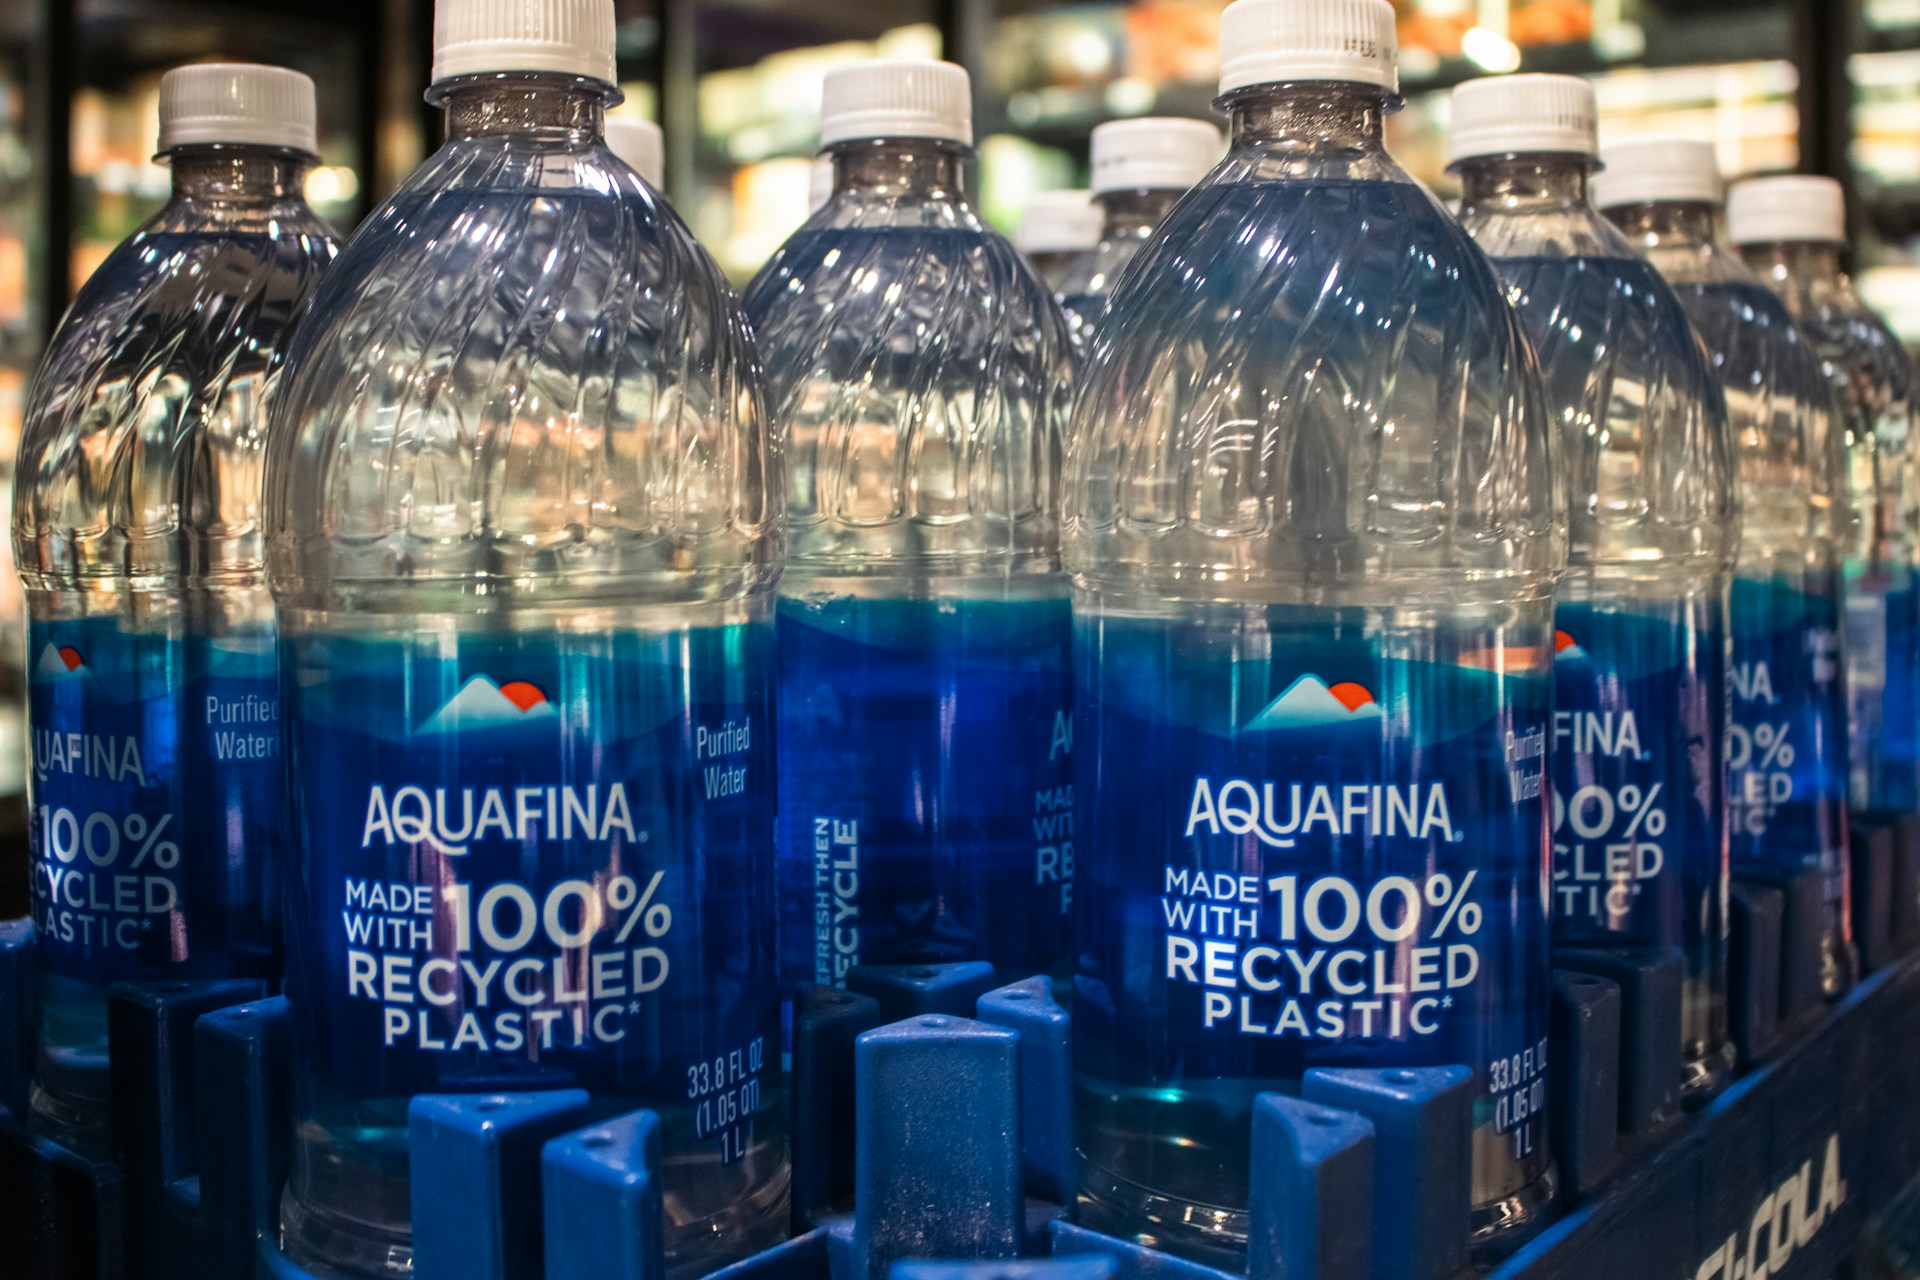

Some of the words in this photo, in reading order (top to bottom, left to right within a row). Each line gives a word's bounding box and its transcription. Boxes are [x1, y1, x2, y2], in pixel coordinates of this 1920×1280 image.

[34, 728, 146, 788] UAFINA
[215, 731, 275, 760] Water
[697, 717, 750, 760] Purified
[704, 765, 747, 801] Water
[1554, 782, 1667, 839] 0%
[39, 803, 180, 870] 100%
[816, 818, 830, 886] THEN
[30, 861, 178, 914] CYCLED
[345, 878, 434, 915] MADE
[1165, 866, 1259, 903] MADE
[1268, 869, 1483, 943] 100%
[343, 911, 433, 951] WITH
[443, 870, 672, 952] 100%
[1163, 898, 1258, 938] WITH
[348, 946, 670, 1006] RECYCLED
[1166, 934, 1480, 994] RECYCLED
[687, 1056, 725, 1099] 33.8
[730, 1048, 746, 1084] FL
[750, 1036, 764, 1073] OZ
[1490, 1053, 1521, 1094] 33.8
[1523, 1047, 1536, 1082] FL
[696, 1089, 737, 1140] (1.05
[741, 1077, 760, 1116] QT)
[1495, 1087, 1529, 1134] (1.05
[722, 1131, 729, 1164] 1
[735, 1126, 745, 1158] L
[1515, 1126, 1522, 1159] 1
[1525, 1122, 1532, 1154] L
